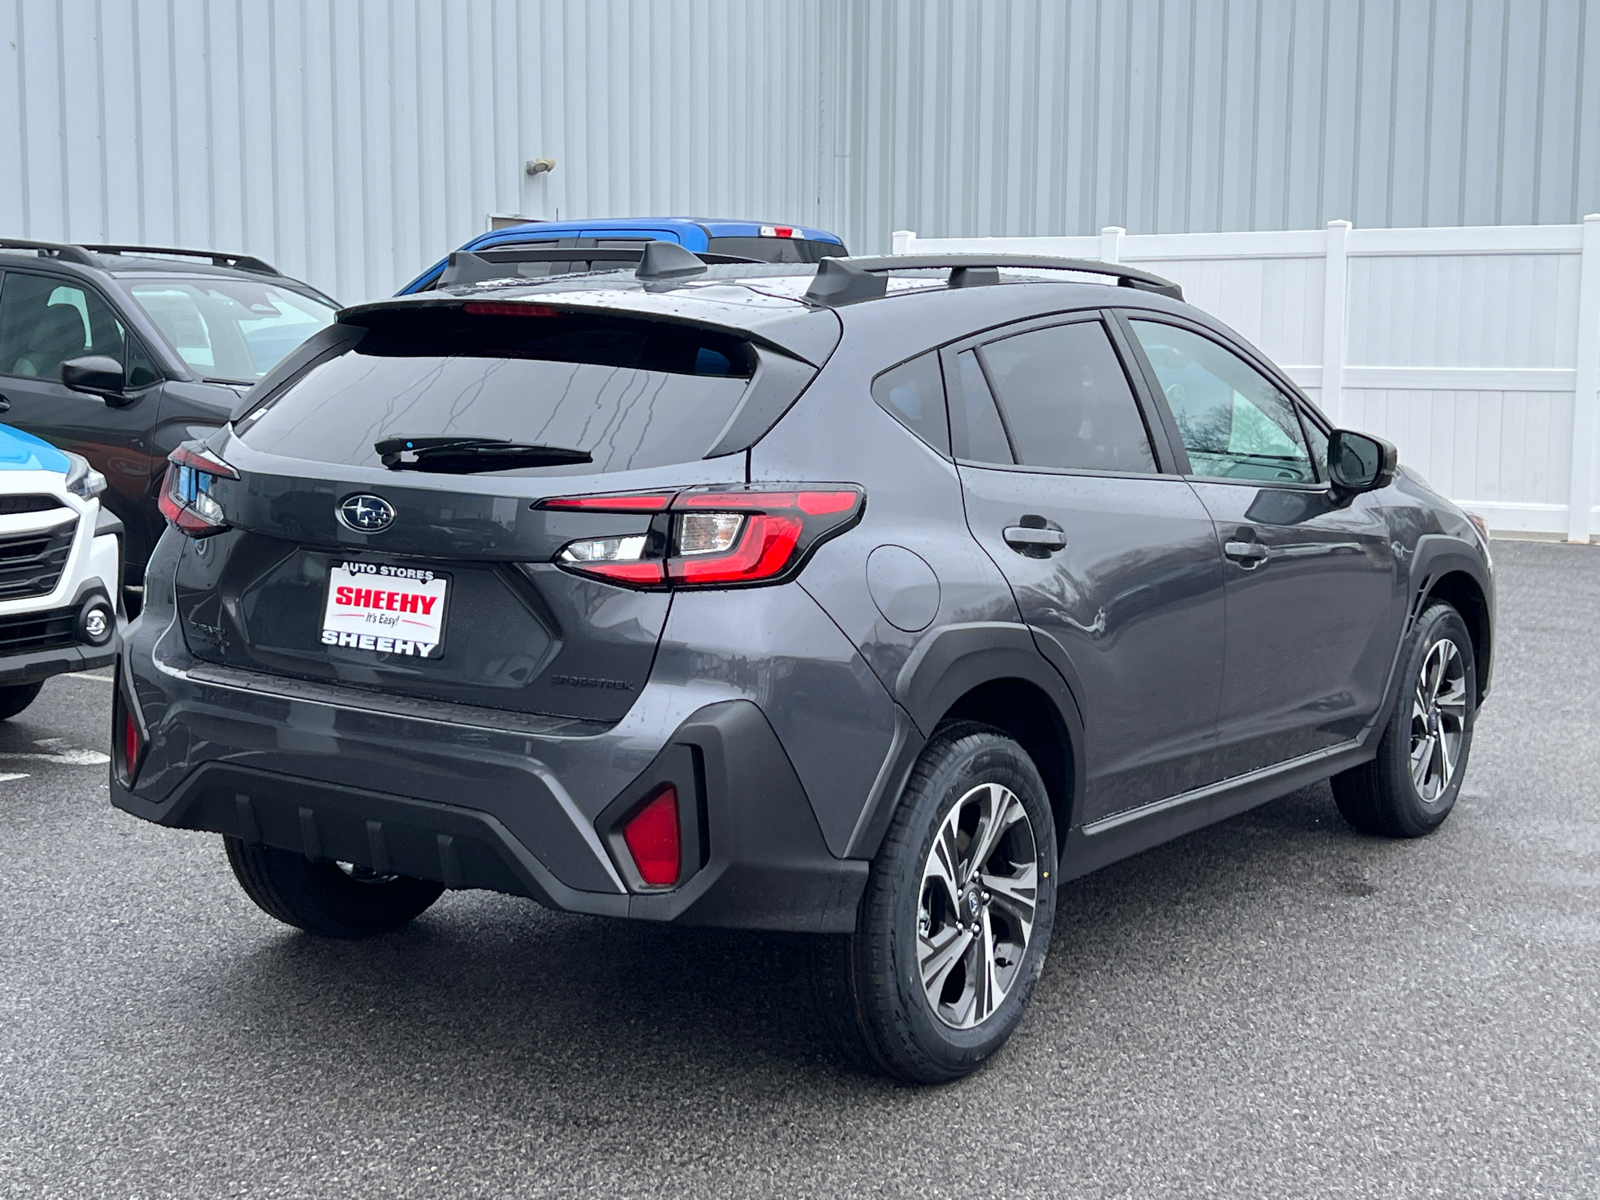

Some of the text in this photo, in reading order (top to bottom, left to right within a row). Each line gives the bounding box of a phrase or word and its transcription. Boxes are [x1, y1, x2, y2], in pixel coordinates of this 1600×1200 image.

[341, 562, 434, 581] AUTO STORES
[335, 586, 438, 615] SHEEHY
[366, 612, 400, 628] It's Easy!
[321, 630, 437, 658] SHEEHY
[551, 674, 635, 692] CROSSTREK
